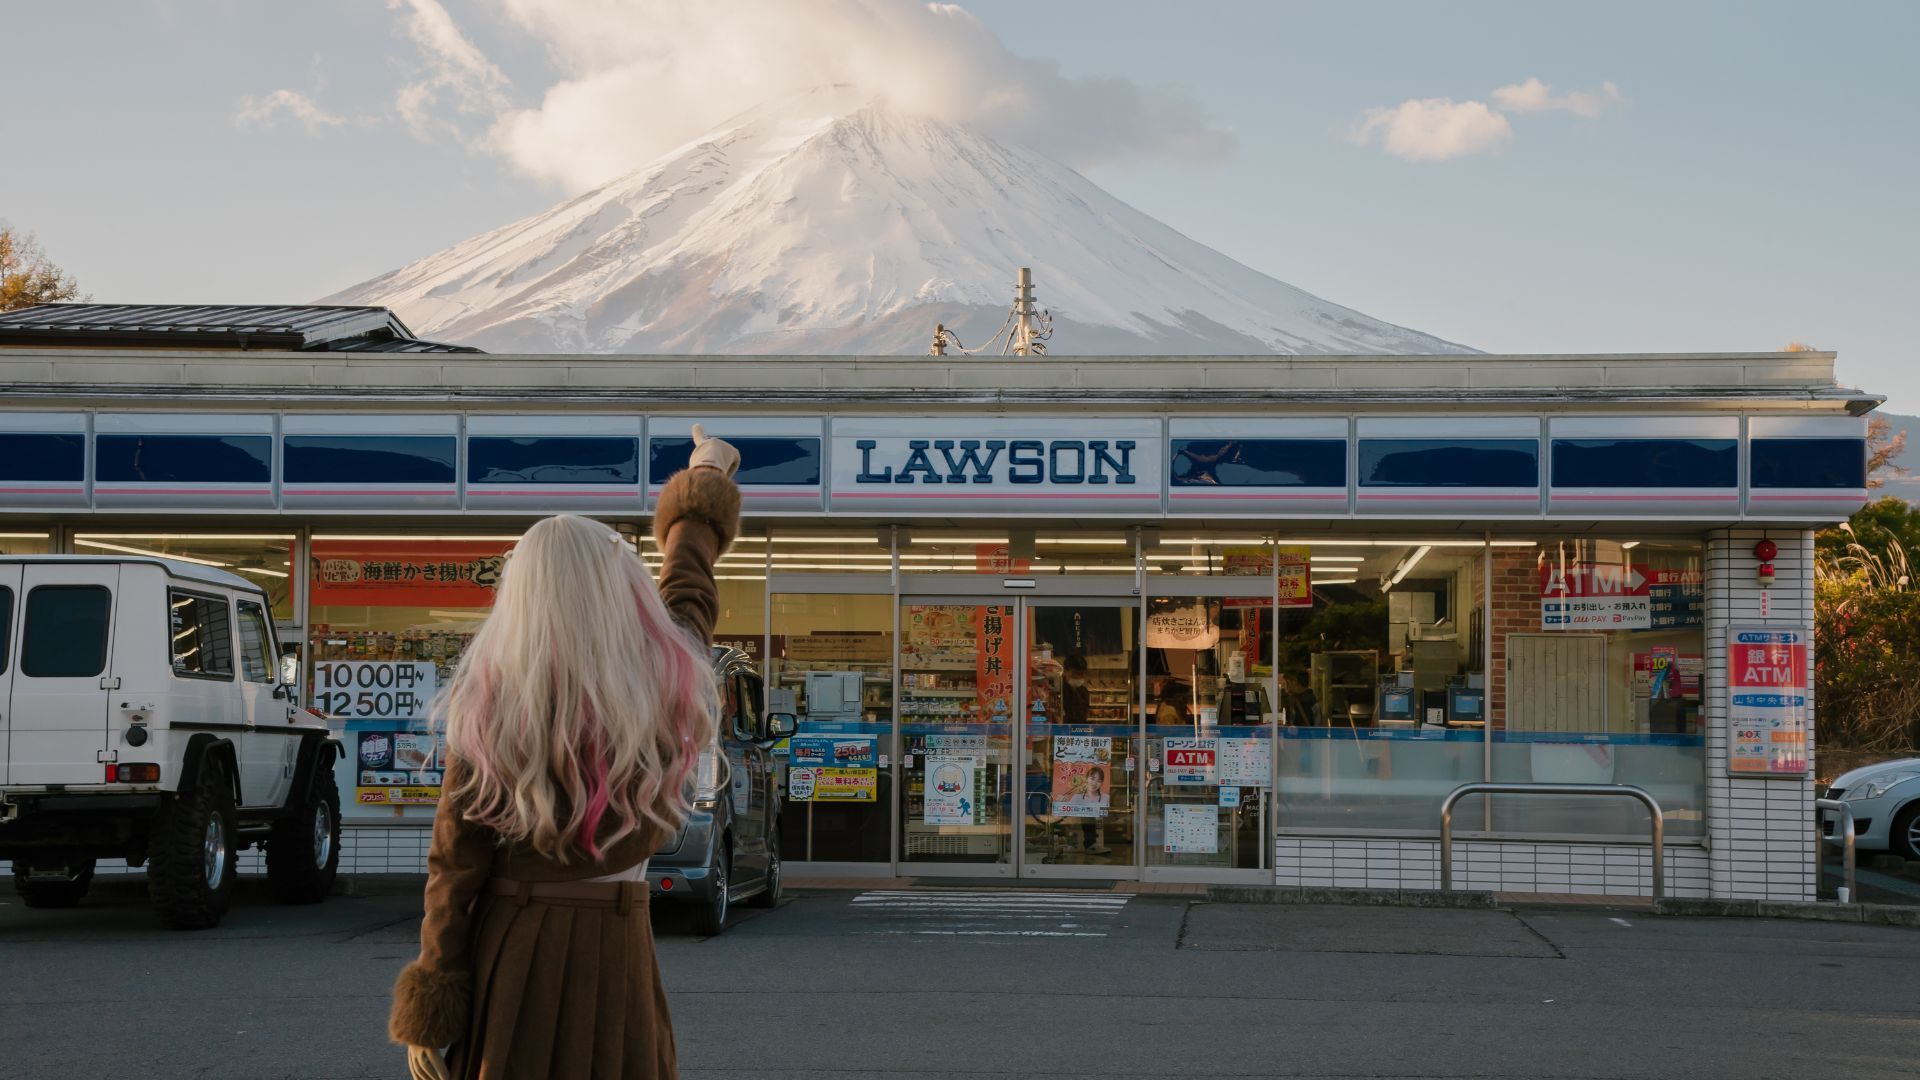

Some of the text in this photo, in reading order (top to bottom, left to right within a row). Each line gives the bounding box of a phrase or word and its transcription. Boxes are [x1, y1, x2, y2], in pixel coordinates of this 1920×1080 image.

[856, 440, 1136, 484] LAWSON
[1544, 568, 1625, 595] ATM
[1741, 634, 1796, 642] ATMサービス
[1747, 649, 1789, 665] 銀行
[1743, 667, 1792, 683] ATM
[1167, 741, 1215, 749] ローソン銀行
[1175, 752, 1208, 764] ATM
